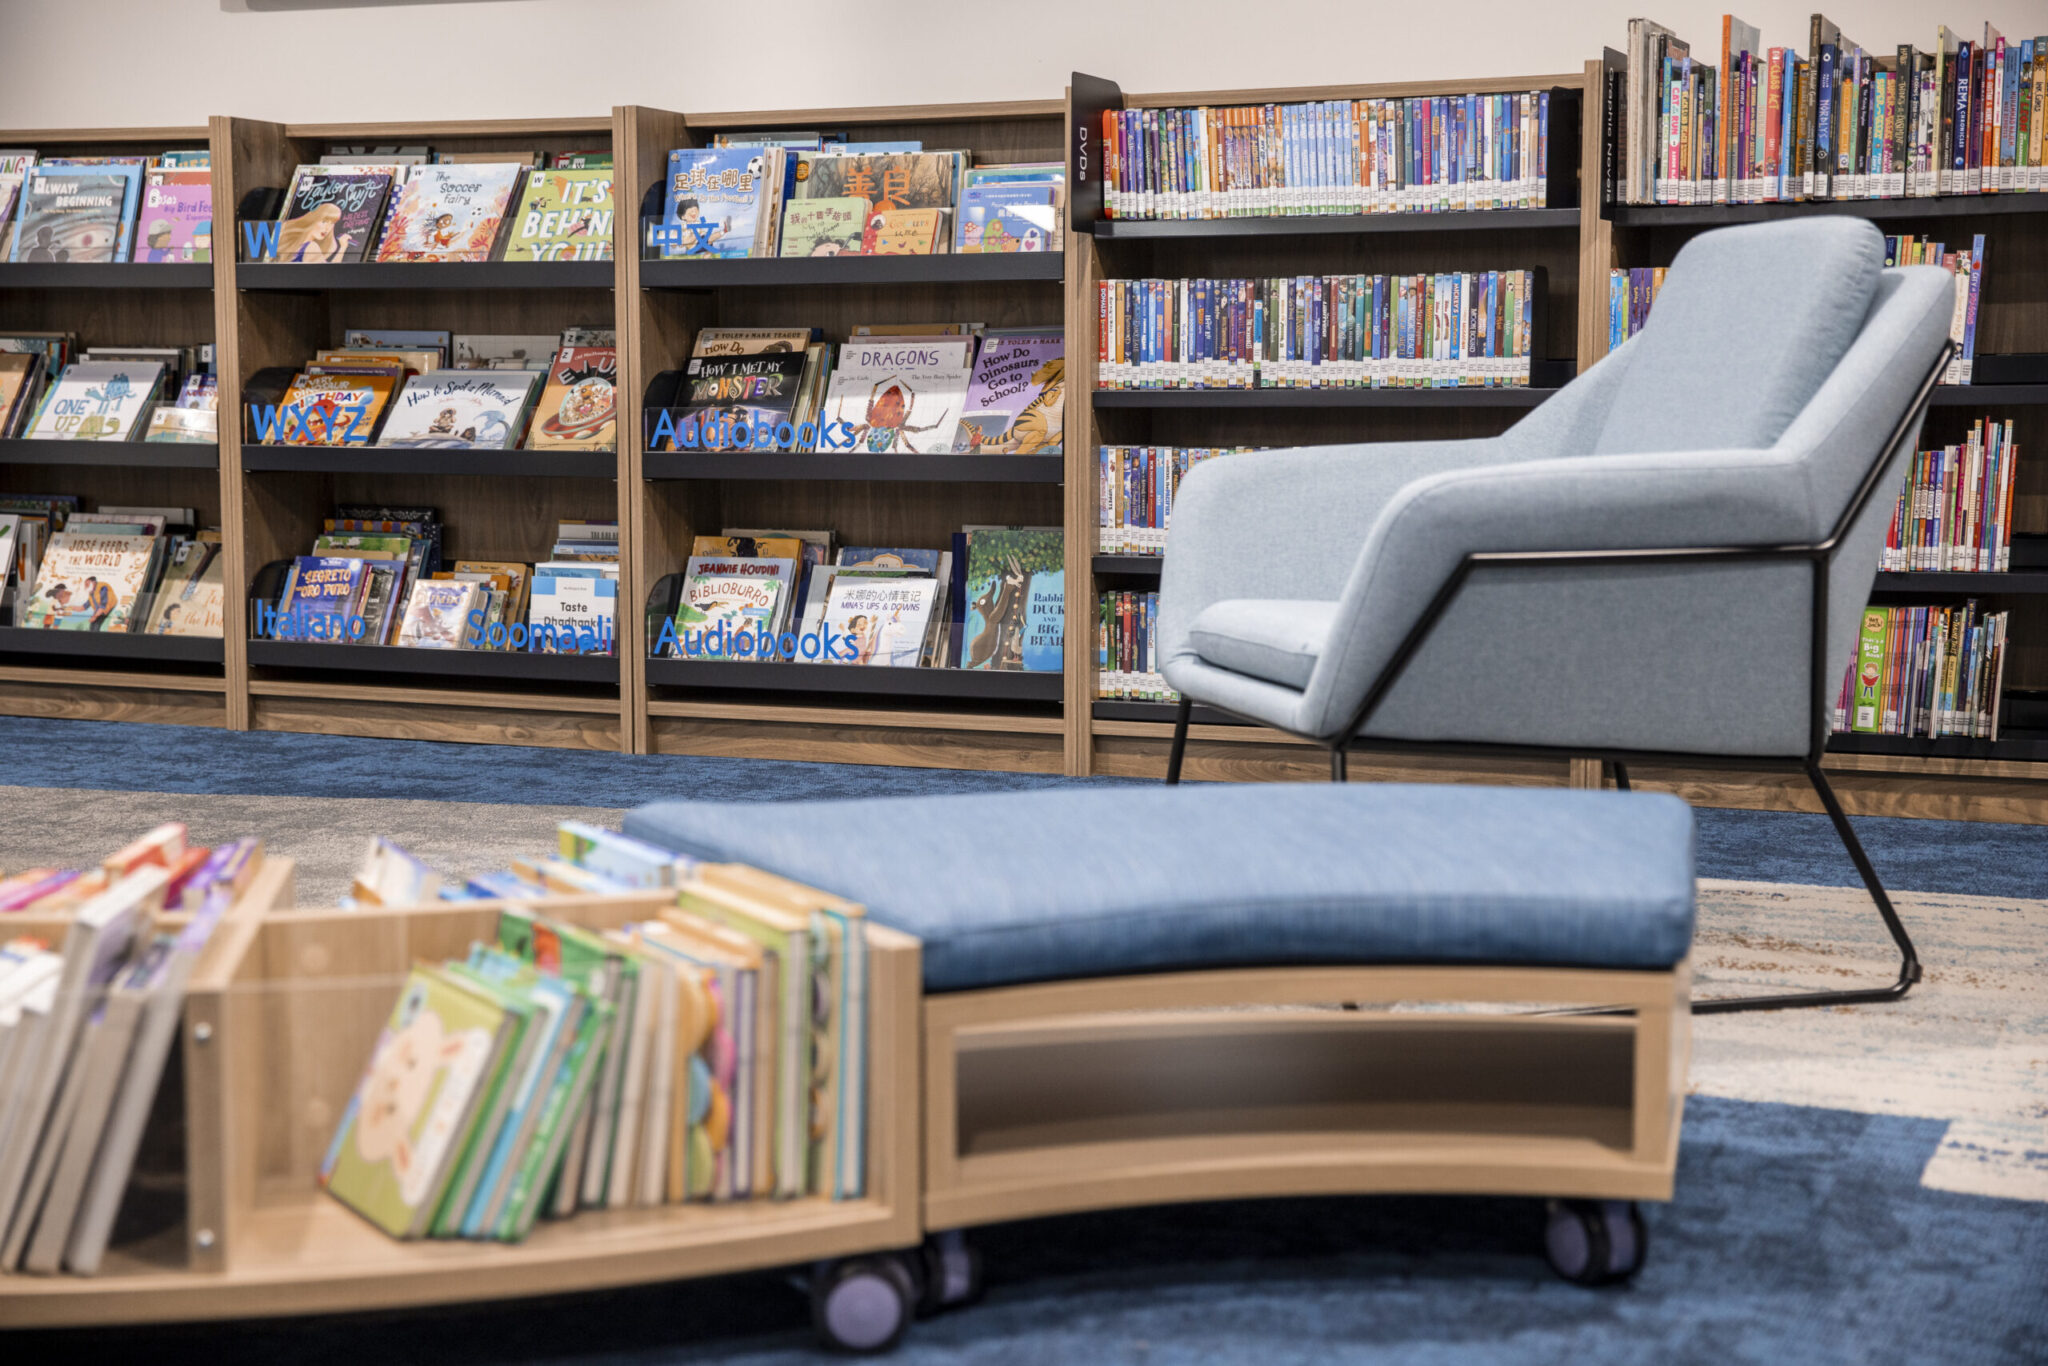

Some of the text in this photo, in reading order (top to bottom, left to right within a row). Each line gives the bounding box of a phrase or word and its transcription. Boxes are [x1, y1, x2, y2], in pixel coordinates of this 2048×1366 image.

[1768, 64, 1781, 110] CLASS ACT
[1671, 87, 1680, 135] CAT RUN
[1957, 78, 1968, 148] REMA CHRONICLES
[2019, 102, 2030, 132] LEON
[436, 171, 451, 181] The
[673, 168, 753, 193] 足球在哪里
[1606, 143, 1614, 203] Novels
[44, 182, 79, 194] LWAYS
[300, 178, 383, 213] Taylor Swift
[439, 182, 482, 194] Soccer
[561, 178, 610, 204] IT'S
[56, 195, 113, 208] BEGINNING
[177, 201, 198, 214] Bird
[443, 194, 472, 206] Fairy
[244, 221, 282, 259] W
[653, 216, 720, 257] 中文
[721, 332, 743, 340] YOLEN
[739, 361, 764, 375] MET
[764, 360, 784, 373] MY
[861, 350, 940, 367] DRAGONS
[982, 348, 1030, 369] How Do
[978, 358, 1040, 384] Dinosaurs
[293, 381, 350, 399] DINOSAUR
[691, 373, 784, 401] MONSTER
[988, 372, 1023, 390] Go to
[406, 390, 430, 407] How
[433, 383, 443, 396] to
[443, 379, 472, 396] Spot
[474, 382, 521, 406] Mermaid
[980, 381, 1029, 407] School?
[54, 399, 90, 415] ONE
[54, 415, 81, 432] UP
[251, 403, 369, 442] WXYZ
[650, 408, 856, 449] Audiobooks
[68, 537, 130, 554] JOSÉ FEEDS
[84, 554, 122, 567] WORLD
[697, 562, 780, 576] JEANNIE HOUDINI
[304, 568, 352, 584] SEGRETO
[323, 582, 351, 597] PURO
[689, 581, 769, 608] BIBLIOBURRO
[843, 588, 922, 602] 米娜的心情笔记
[560, 601, 588, 613] Taste
[840, 601, 864, 610] MINA'S
[866, 602, 879, 611] UPS
[890, 602, 921, 612] DOWNS
[256, 598, 367, 640] Italiano
[544, 616, 602, 628] Dhadhank
[467, 608, 613, 652] Soomaali
[1038, 624, 1059, 634] BIG
[653, 616, 860, 661] Audiobooks
[1864, 643, 1880, 654] Big
